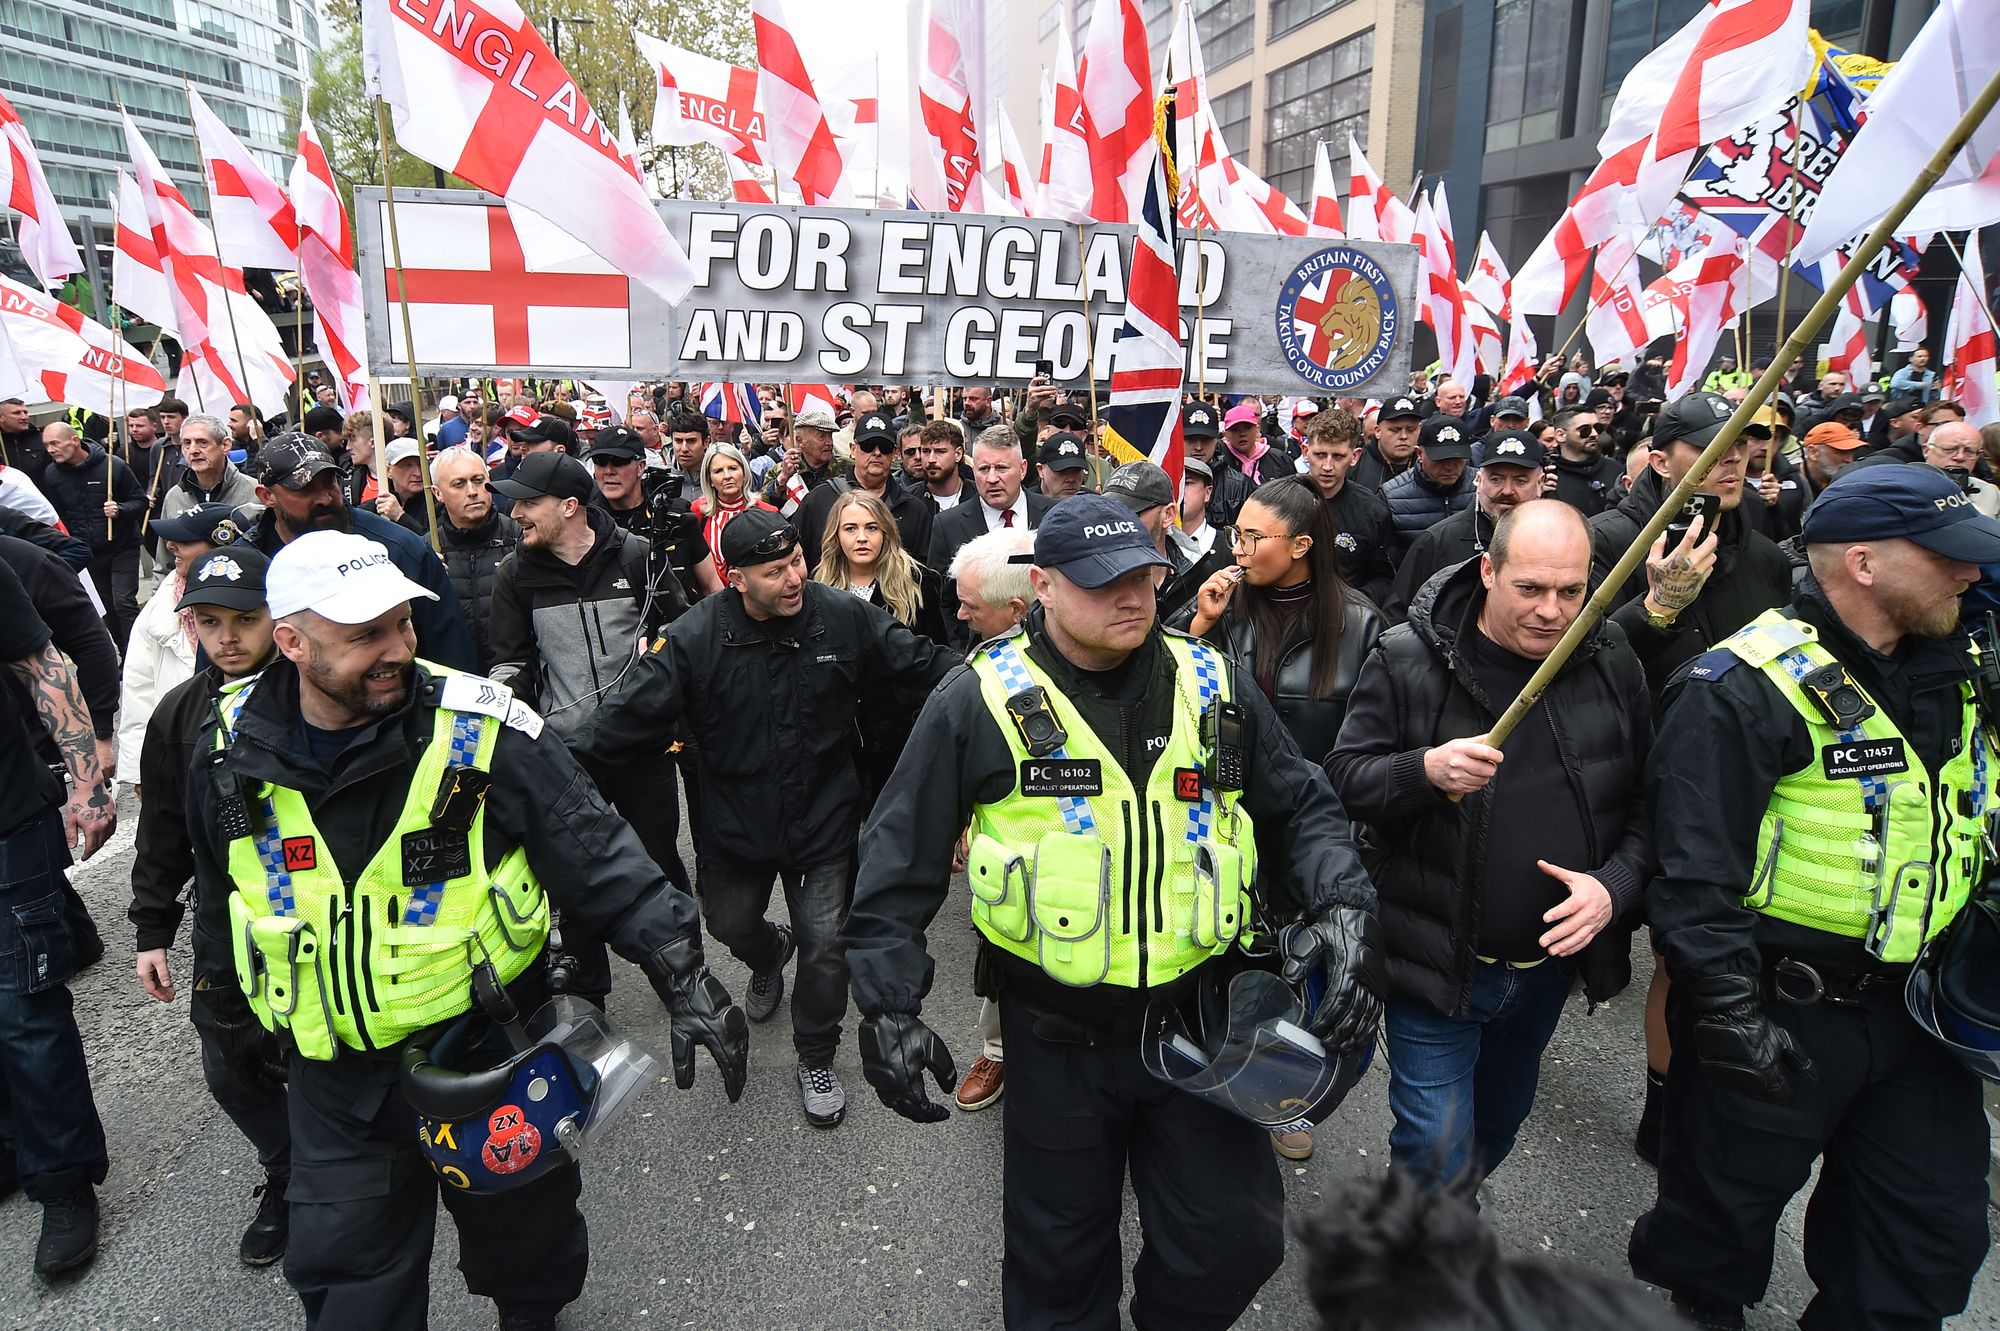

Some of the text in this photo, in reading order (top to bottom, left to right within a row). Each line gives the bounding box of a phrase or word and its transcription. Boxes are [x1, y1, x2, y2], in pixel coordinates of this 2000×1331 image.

[688, 211, 1226, 308] FOR ENGLAD
[1297, 251, 1386, 285] BRITAIN FIRST
[679, 301, 1234, 385] AND ST GEOE
[1279, 303, 1395, 387] TAKING OUR COUNTRY BACK
[1083, 521, 1139, 540] POLICE
[1833, 746, 1894, 765] PC 17457
[1030, 766, 1091, 781] PC 16102
[1829, 761, 1904, 775] SPECIALIST OPERATIONS
[1180, 777, 1198, 792] XZ
[287, 844, 313, 863] XZ
[408, 855, 436, 873] XZ
